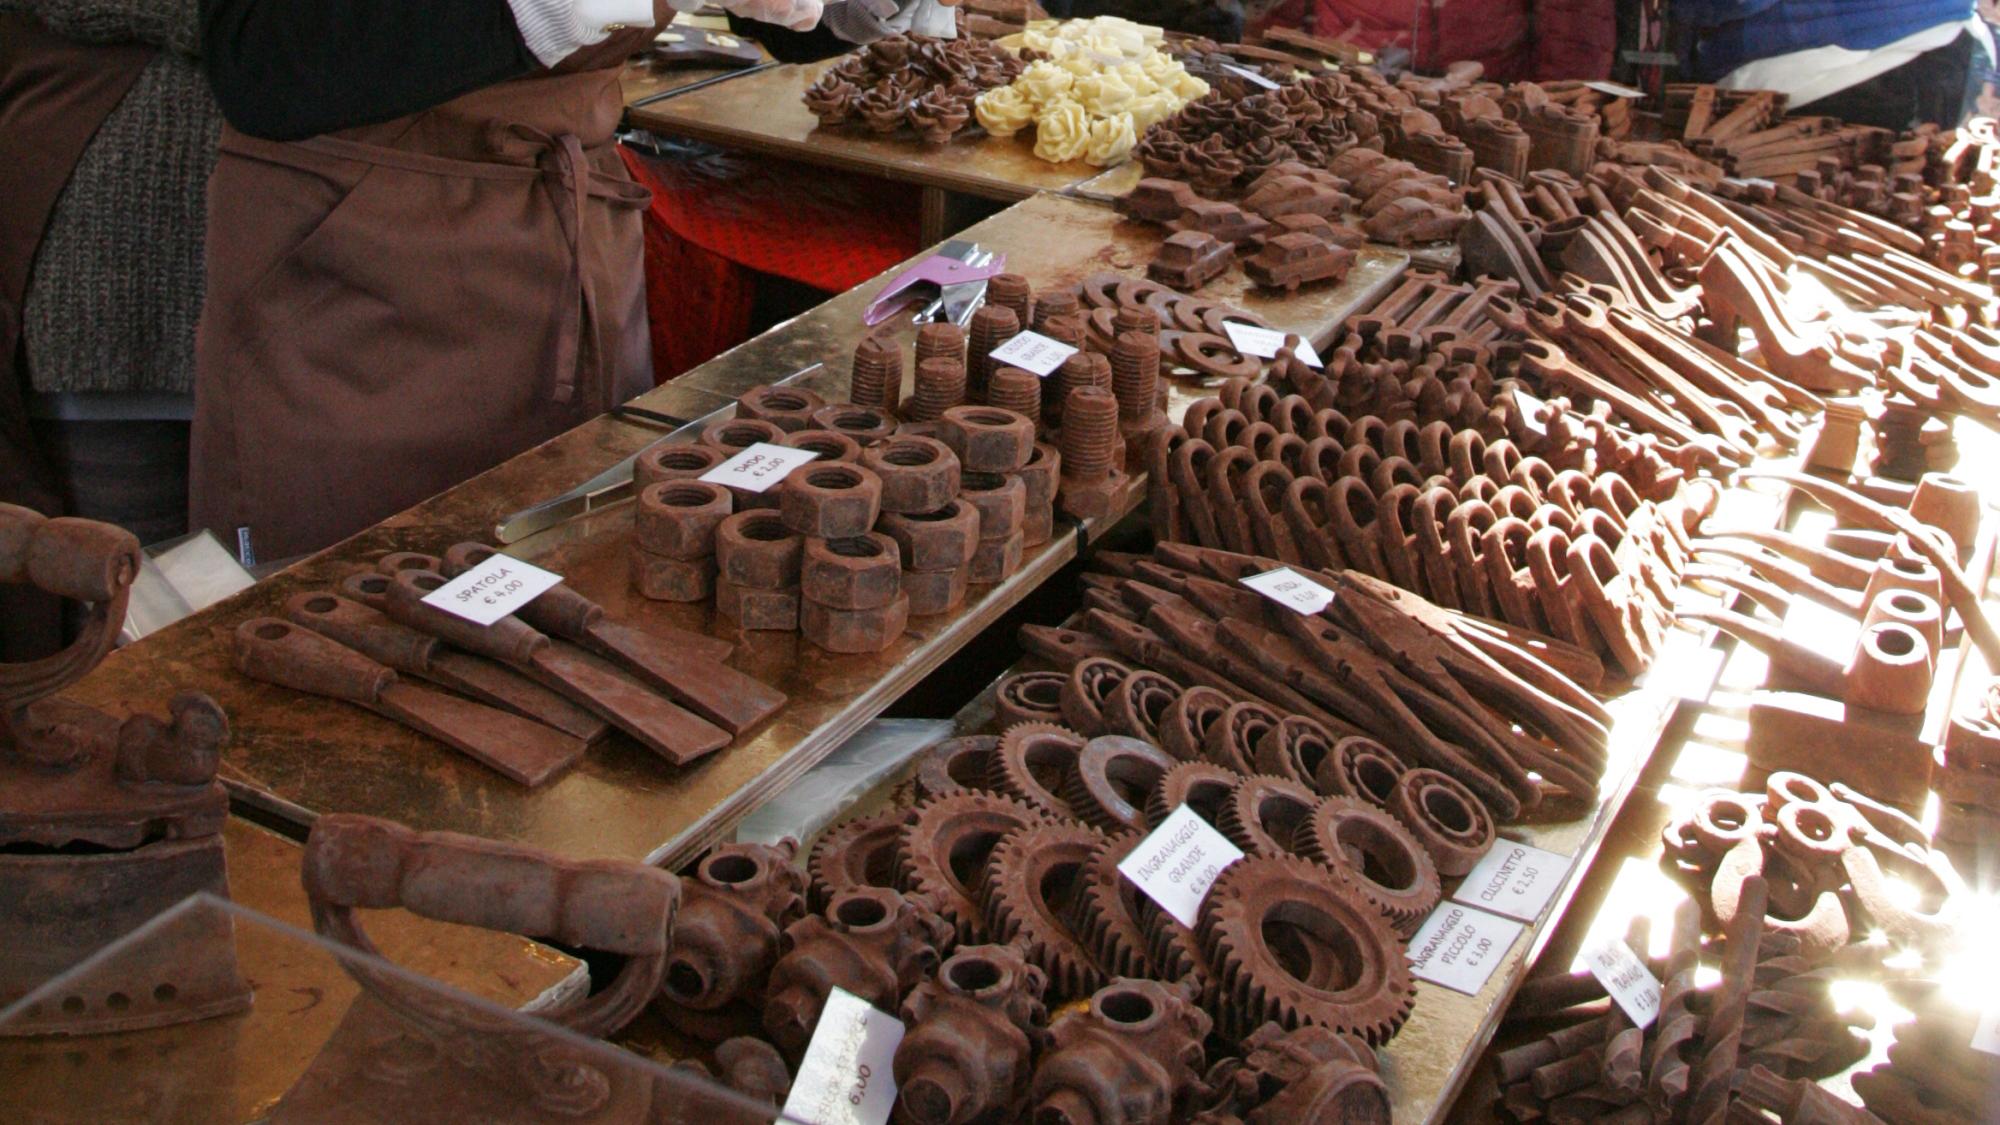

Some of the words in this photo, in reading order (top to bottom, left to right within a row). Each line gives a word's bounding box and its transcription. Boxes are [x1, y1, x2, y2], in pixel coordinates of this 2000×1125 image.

[733, 455, 766, 473] DADO
[456, 568, 513, 602] SPATOLA
[483, 596, 497, 605] €
[494, 580, 523, 598] 4,00
[1137, 819, 1199, 881] INGRANAGGIO
[1168, 844, 1206, 883] GRANDE
[1480, 848, 1526, 901] CUSCINETTO
[1512, 886, 1525, 895] €
[1523, 866, 1539, 888] 2,50
[1413, 908, 1464, 970] INGRANAGGIO
[1441, 924, 1476, 965] PICCOLO
[1466, 957, 1478, 967] €
[1473, 937, 1493, 959] 3,00
[848, 1064, 871, 1105] 6,00
